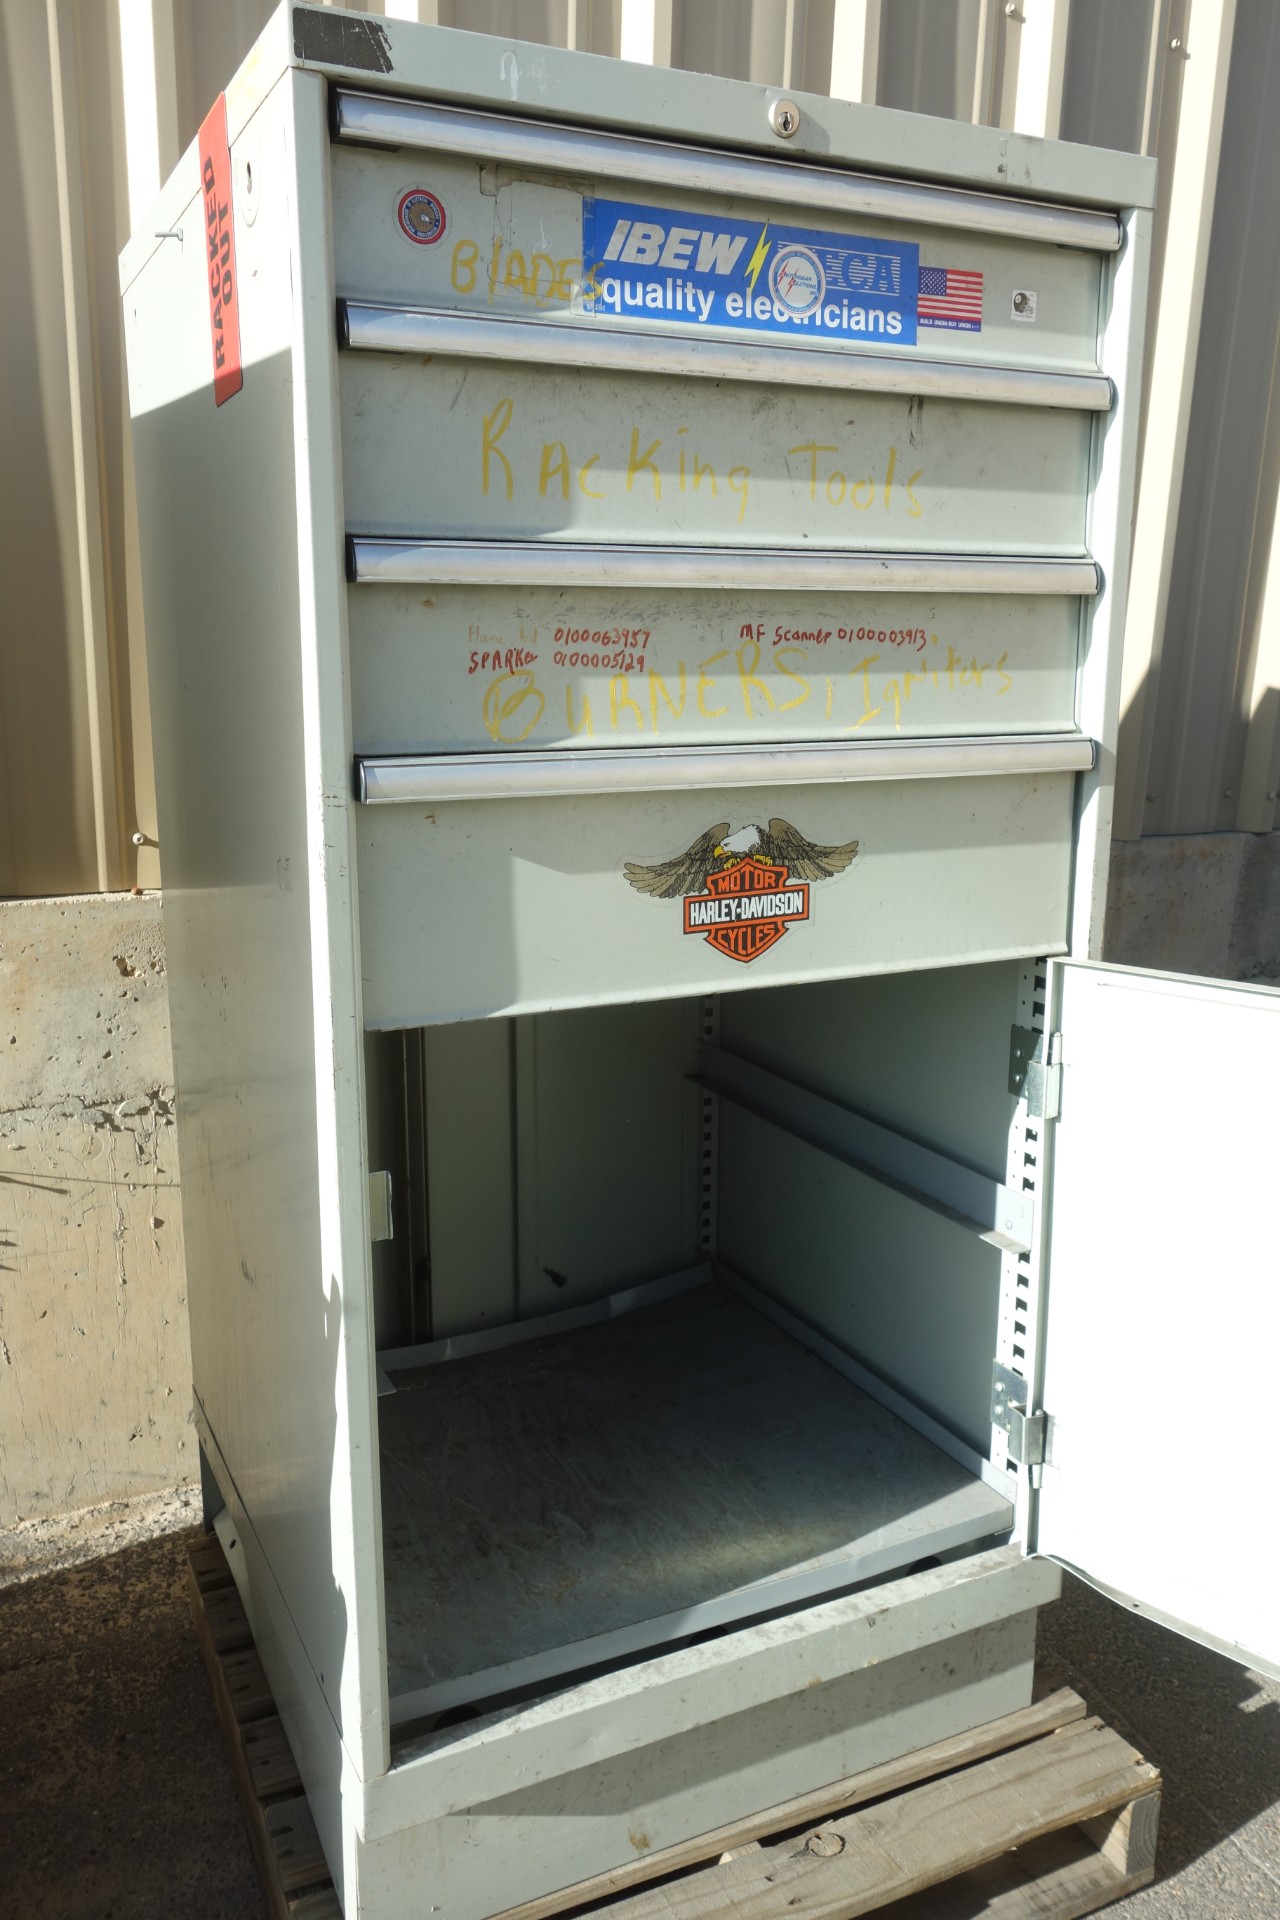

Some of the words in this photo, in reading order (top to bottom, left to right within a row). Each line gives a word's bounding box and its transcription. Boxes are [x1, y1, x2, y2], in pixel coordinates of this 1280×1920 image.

[203, 155, 226, 370] RACKED
[216, 201, 233, 306] OUT
[602, 218, 748, 277] IBEW
[601, 276, 716, 322] quality
[726, 287, 903, 335] elecicians
[717, 863, 776, 892] MOTOR
[689, 890, 804, 926] HARLEY-DAVIDSON
[716, 923, 776, 956] CYCLES
